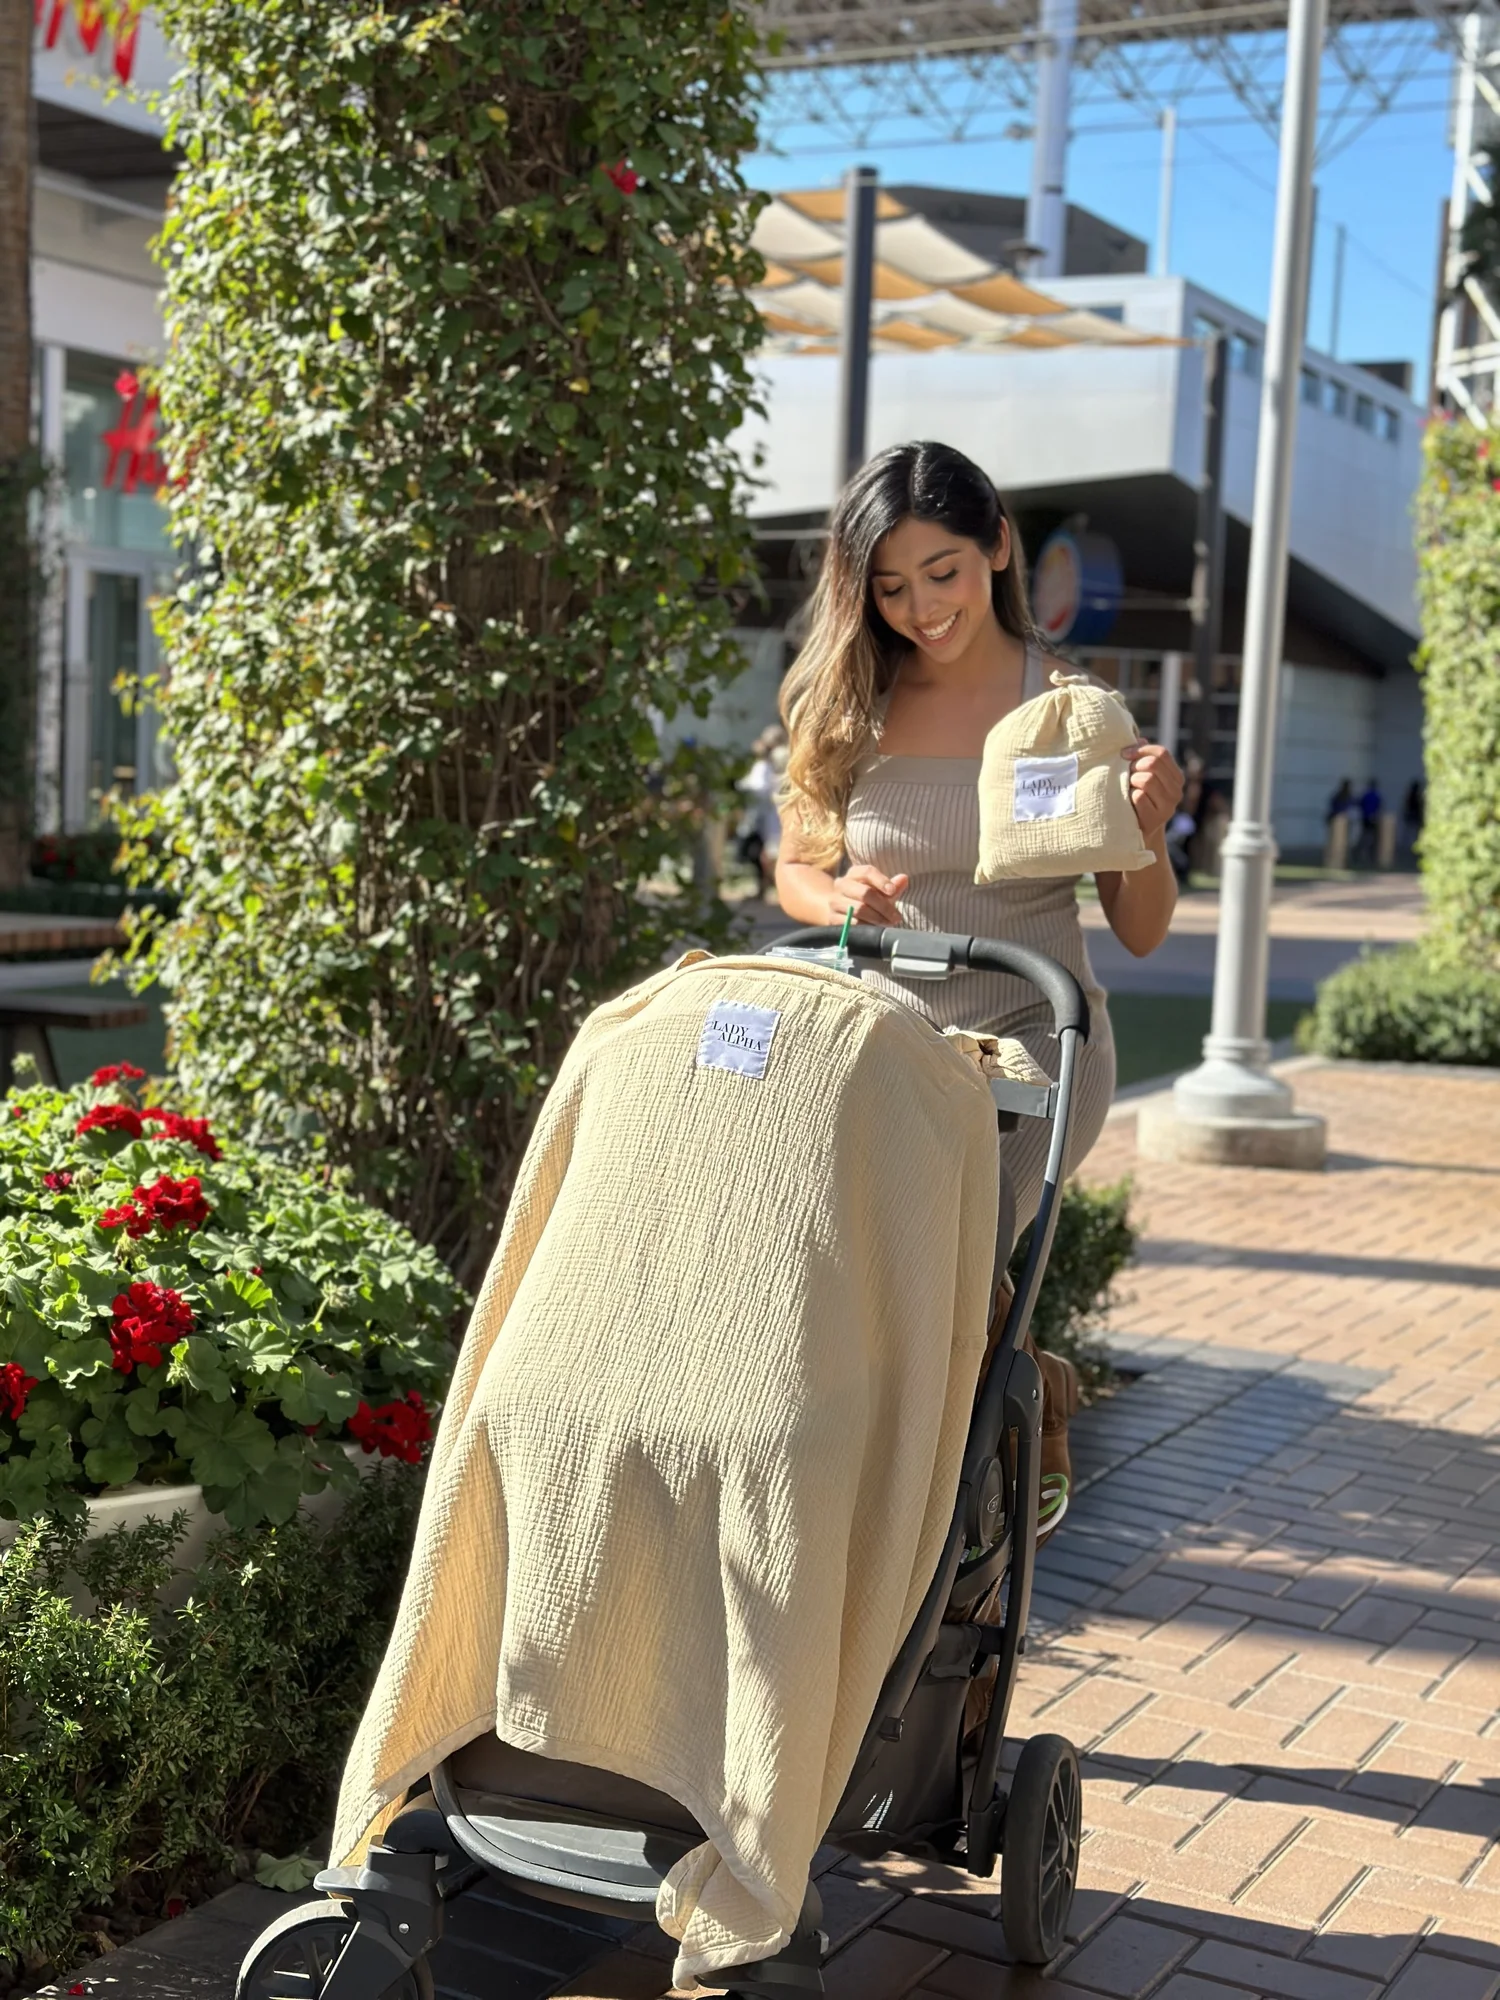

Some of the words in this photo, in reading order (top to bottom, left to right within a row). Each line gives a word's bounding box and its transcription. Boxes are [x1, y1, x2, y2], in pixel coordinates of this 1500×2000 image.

[1022, 778, 1055, 791] LADY
[713, 1021, 749, 1037] LADY
[718, 1032, 761, 1051] ALPHA
